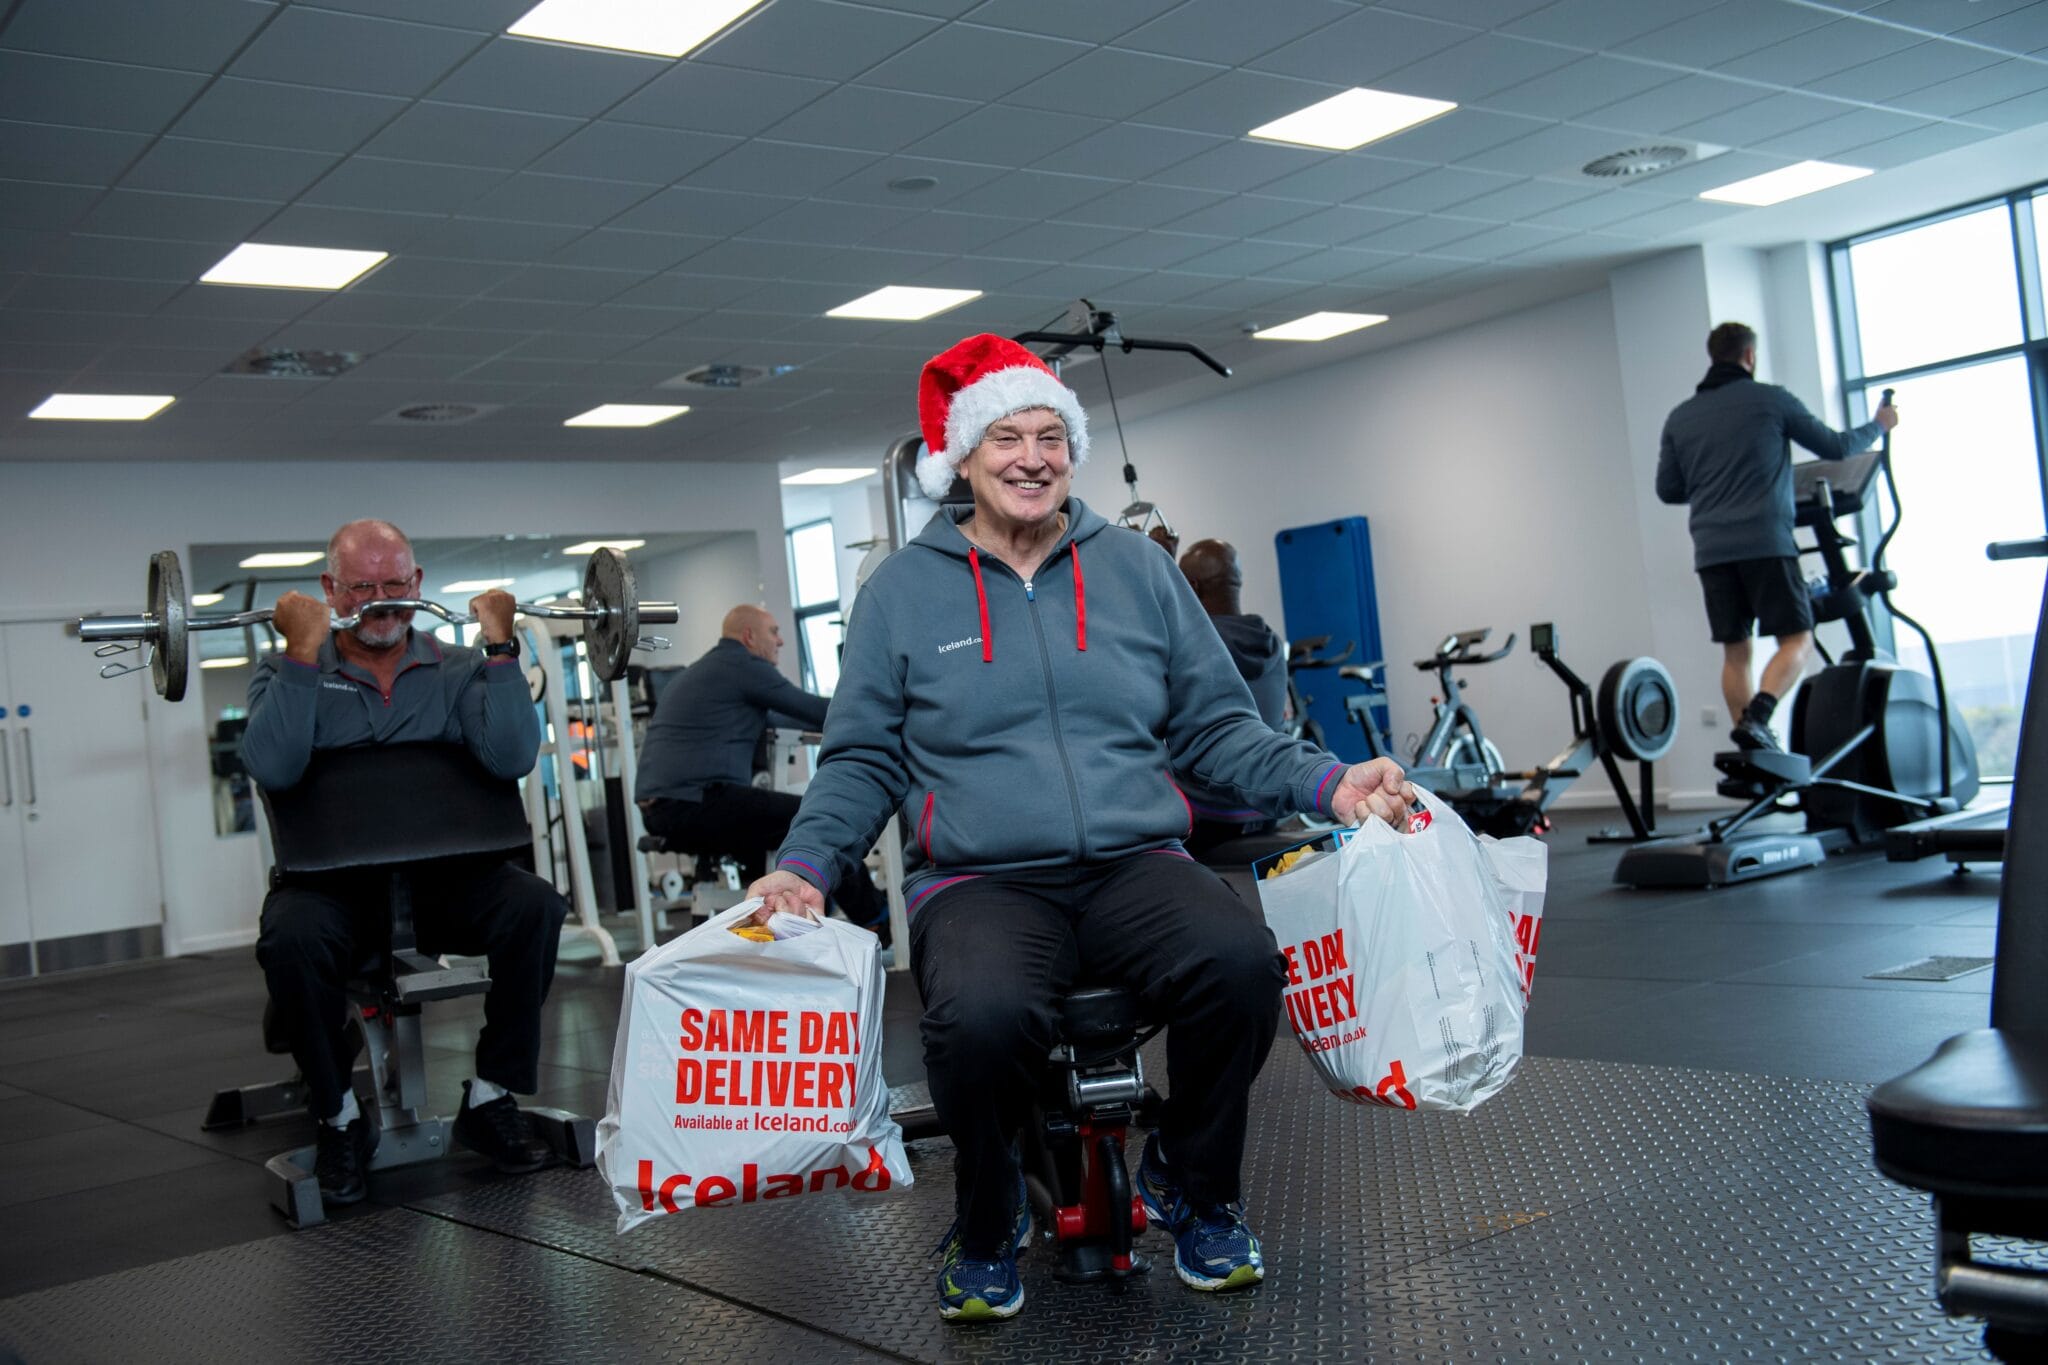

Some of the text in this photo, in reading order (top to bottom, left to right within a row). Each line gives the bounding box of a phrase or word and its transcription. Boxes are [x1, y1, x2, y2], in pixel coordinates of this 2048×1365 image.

[680, 1008, 788, 1054] SAME
[675, 1059, 857, 1108] DELIVERY
[675, 1114, 732, 1131] Available
[736, 1116, 749, 1131] at
[638, 1145, 891, 1214] Iceland
